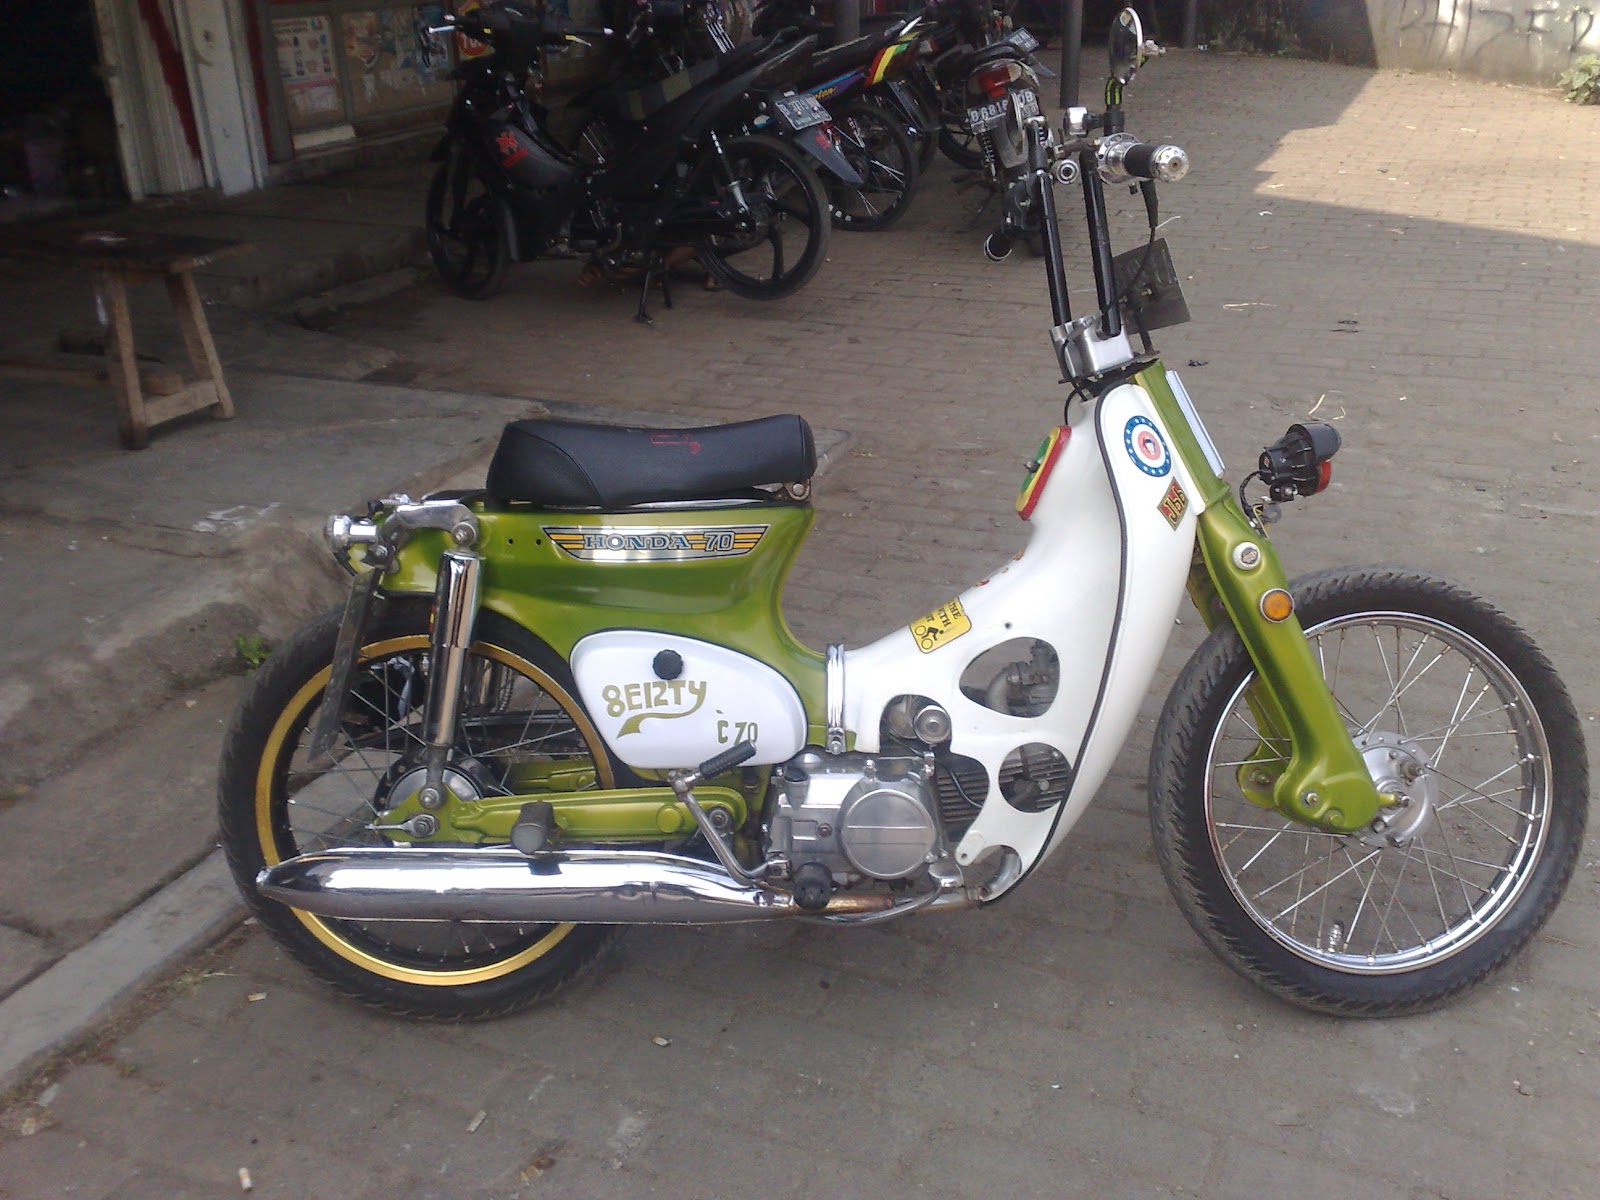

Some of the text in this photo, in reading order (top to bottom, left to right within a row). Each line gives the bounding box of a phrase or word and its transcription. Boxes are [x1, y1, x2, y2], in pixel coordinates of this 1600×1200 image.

[584, 531, 735, 552] HONDA 70
[717, 719, 758, 746] C 70
